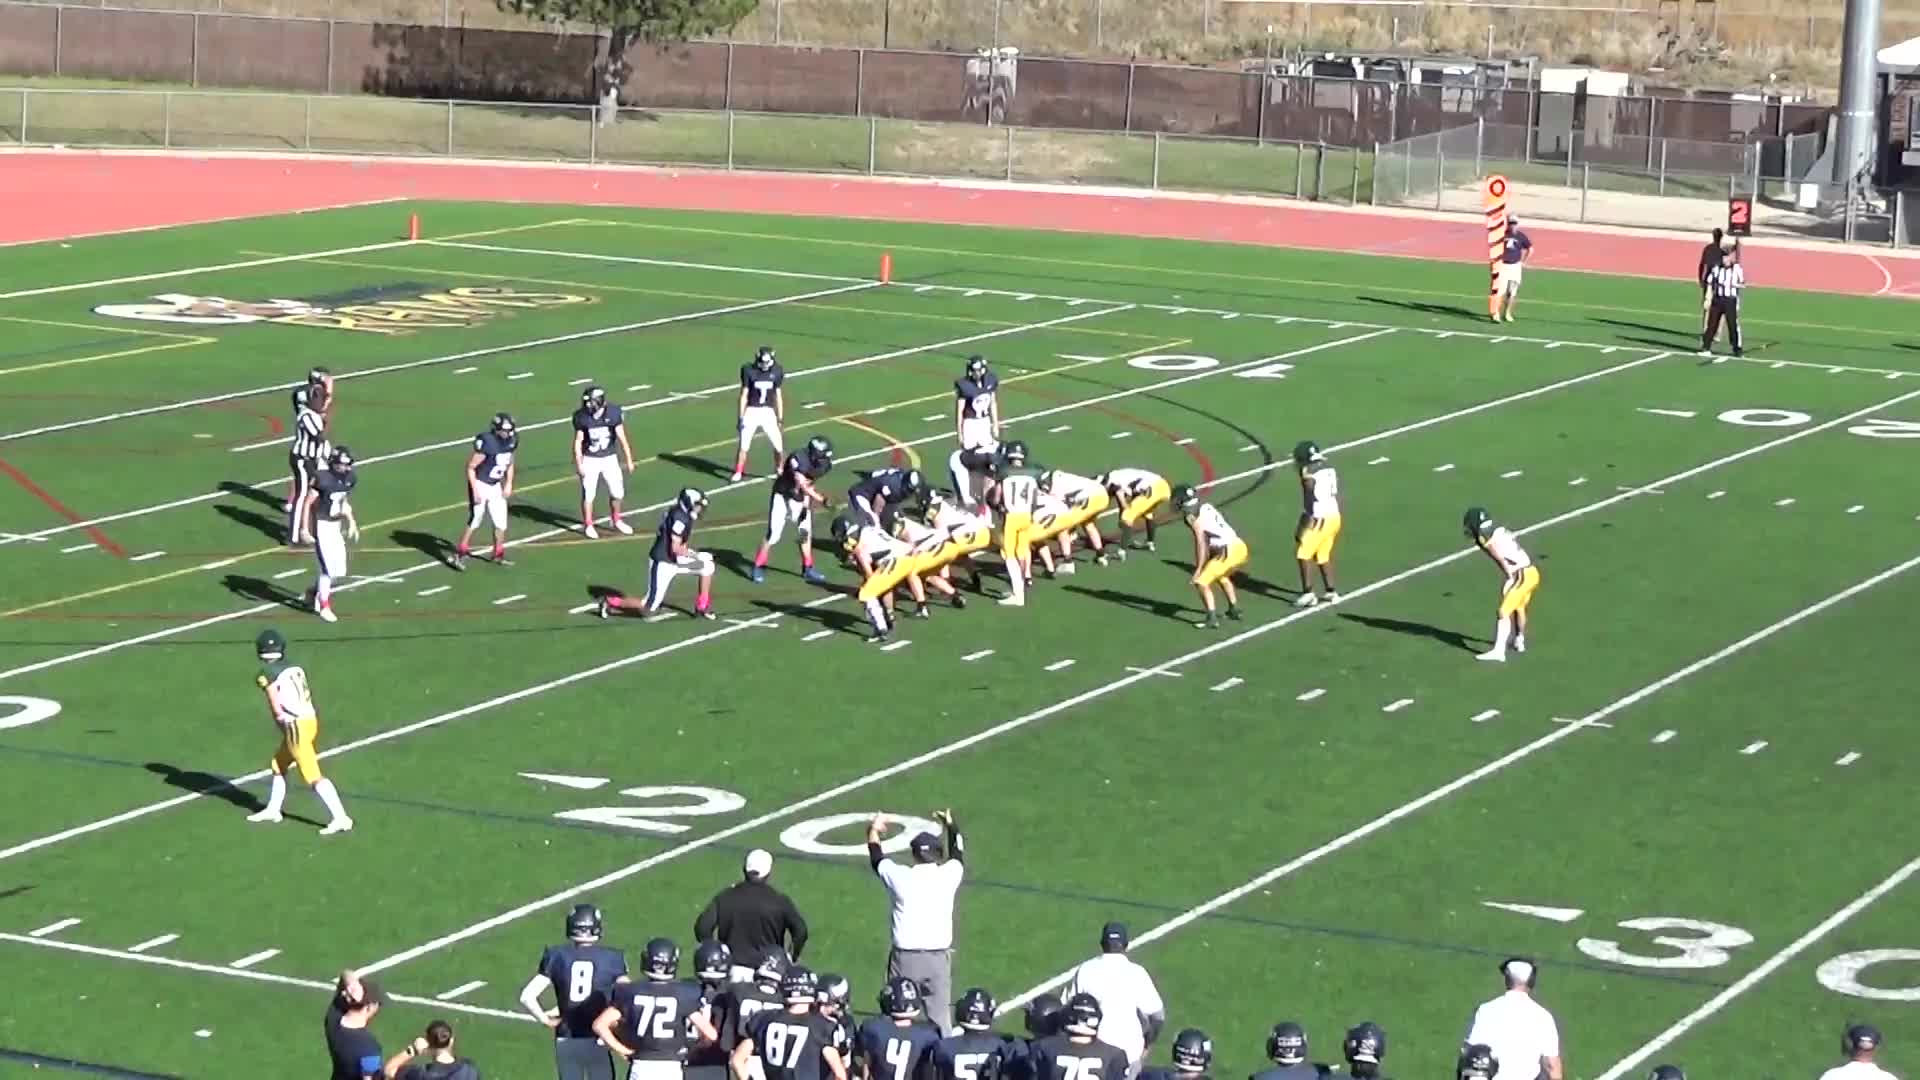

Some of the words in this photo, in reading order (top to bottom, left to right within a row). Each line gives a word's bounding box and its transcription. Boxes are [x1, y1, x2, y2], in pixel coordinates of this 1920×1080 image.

[1730, 202, 1748, 225] 2
[265, 287, 596, 335] RAMS
[1010, 481, 1031, 505] 14
[569, 960, 595, 1002] 8
[633, 995, 678, 1039] 72
[765, 1022, 809, 1069] 87
[885, 1038, 912, 1080] 4
